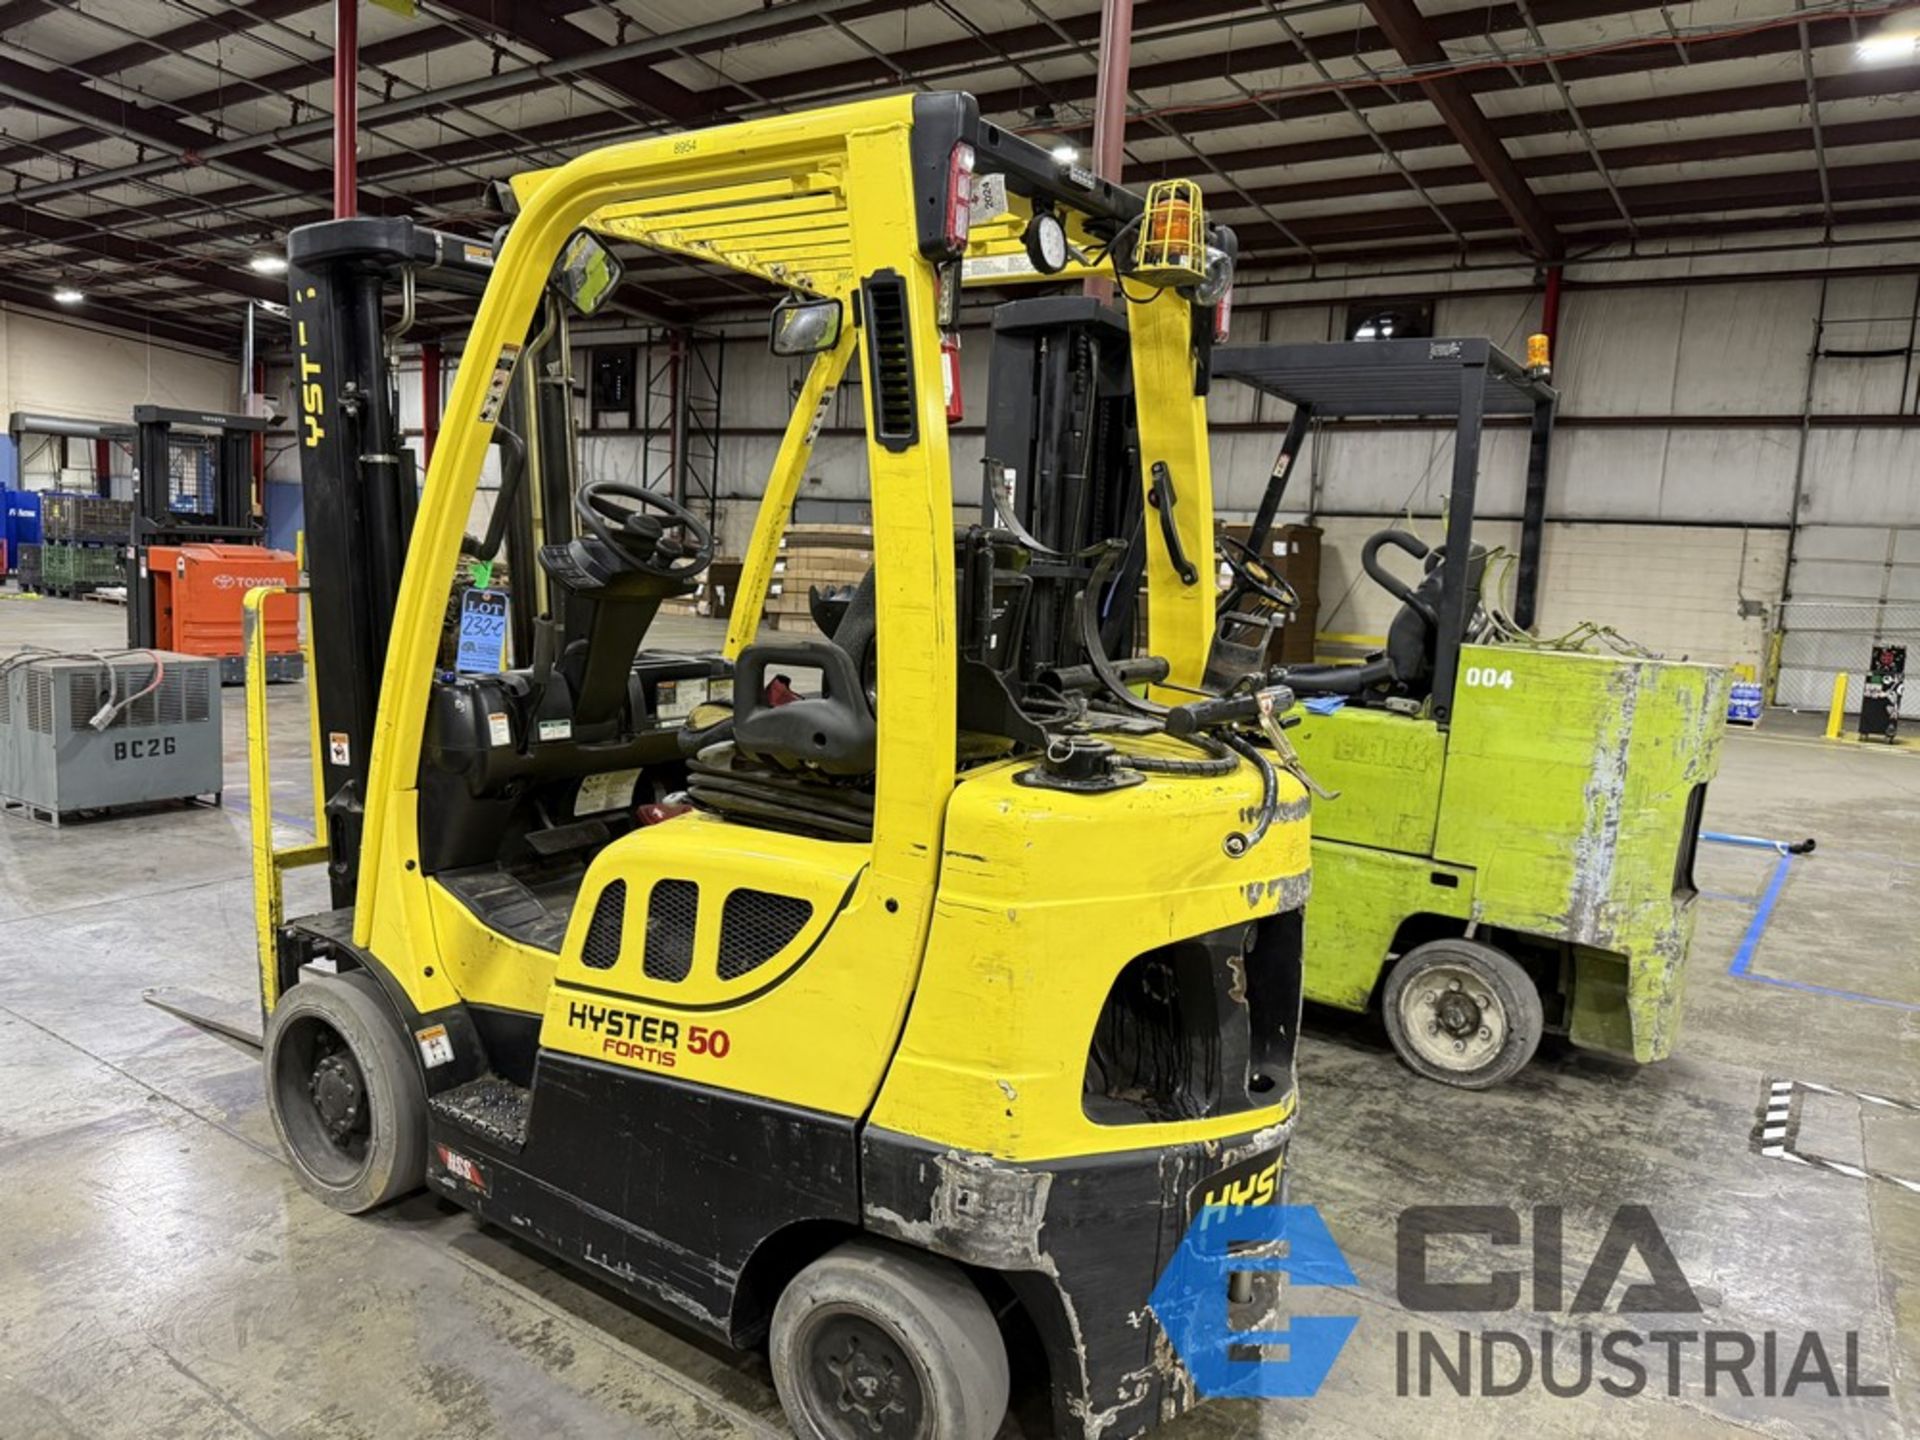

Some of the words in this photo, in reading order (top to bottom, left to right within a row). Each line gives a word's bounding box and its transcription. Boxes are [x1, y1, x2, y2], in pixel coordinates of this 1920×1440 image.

[673, 140, 697, 154] 8954
[981, 181, 995, 210] 2024
[235, 577, 287, 588] TOYOTA
[467, 600, 504, 615] LOT
[1466, 667, 1514, 690] 004
[114, 736, 176, 761] BC26
[568, 1001, 680, 1049] HYSTER
[687, 1025, 731, 1058] 50
[602, 1038, 677, 1068] FORTIS
